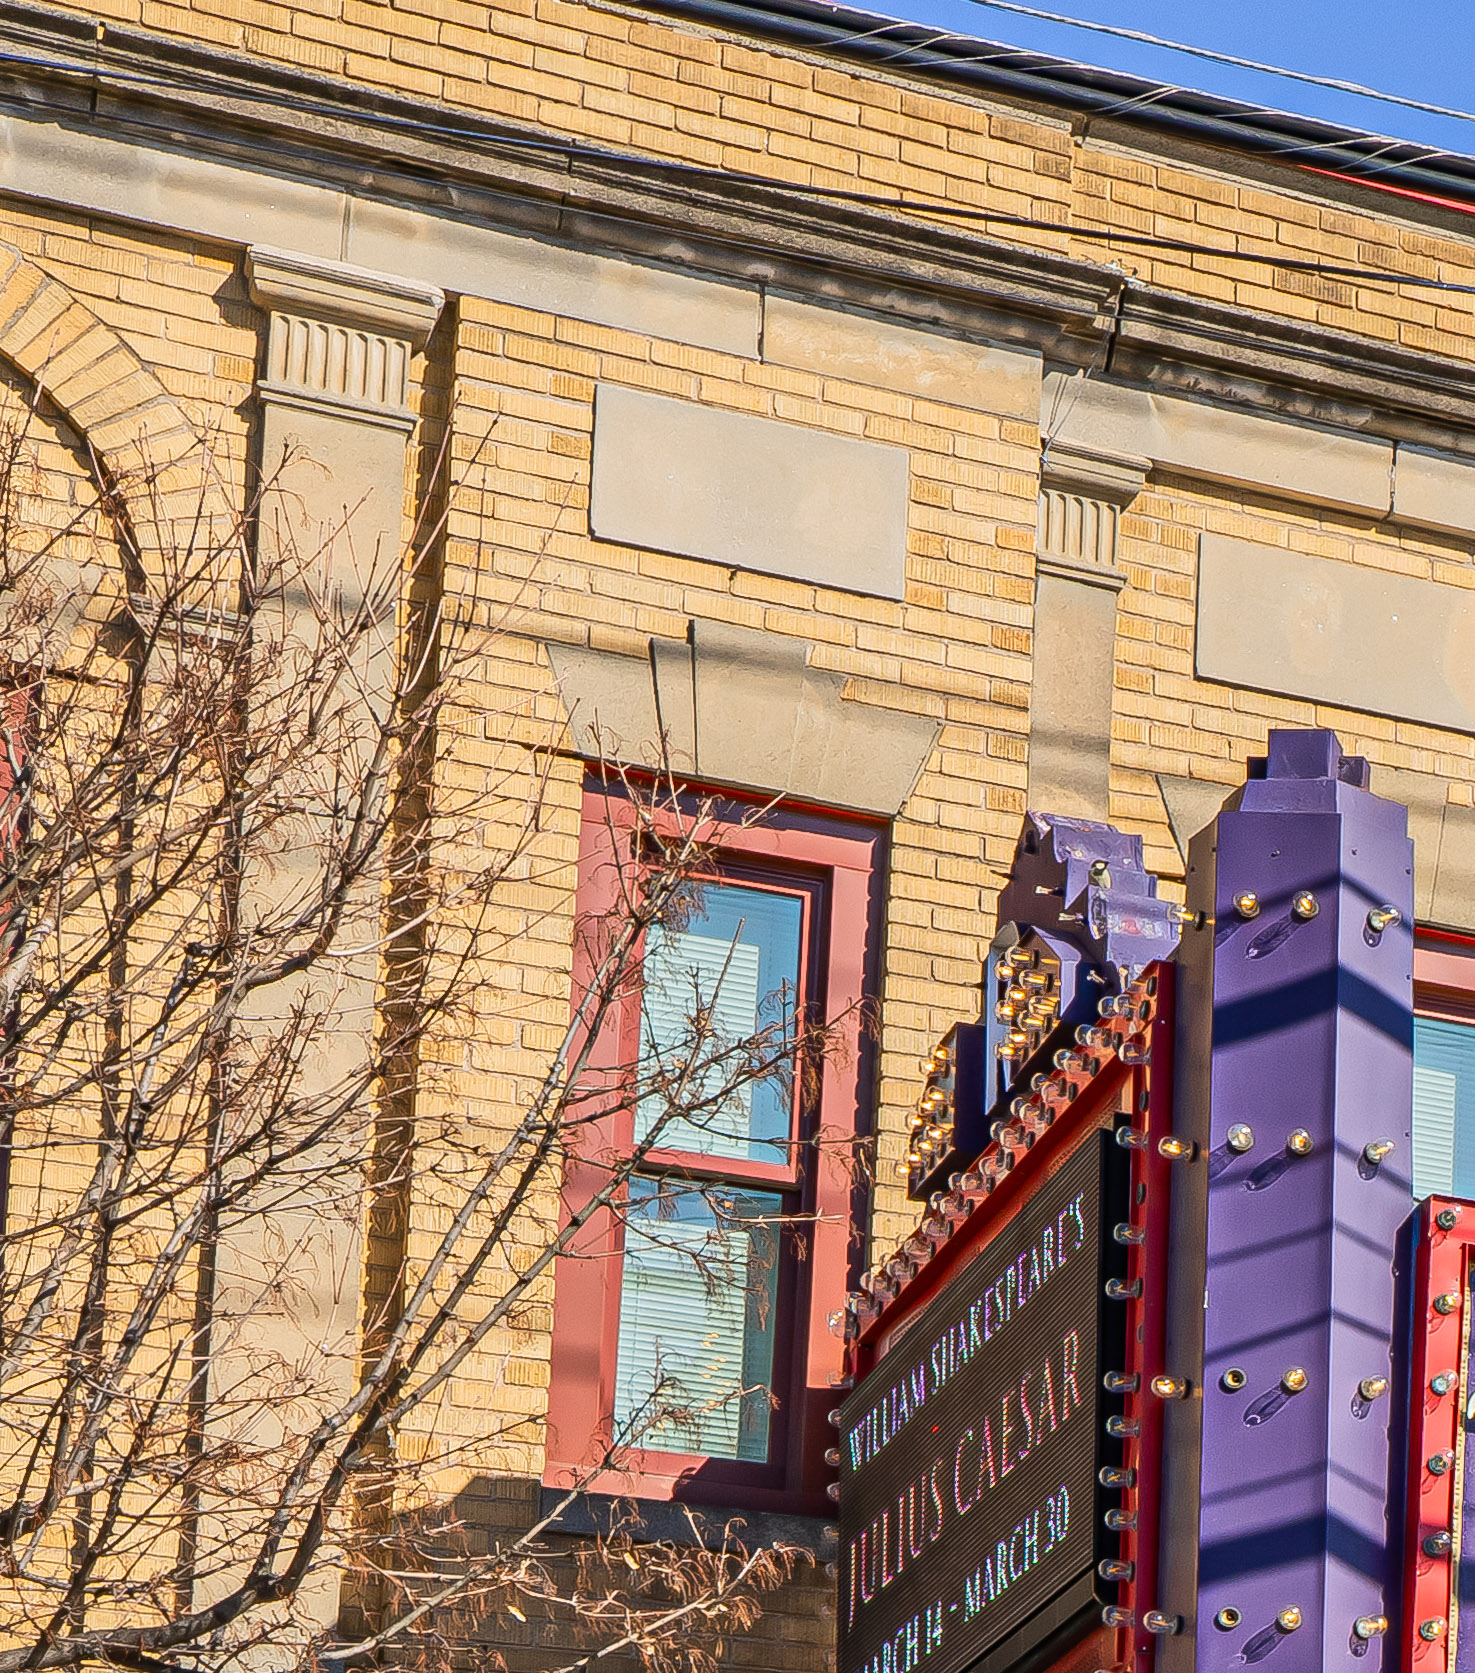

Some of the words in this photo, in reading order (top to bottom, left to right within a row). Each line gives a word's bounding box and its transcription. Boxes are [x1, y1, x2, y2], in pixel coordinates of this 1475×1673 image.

[850, 1360, 925, 1471] WILLIAM
[931, 1191, 1084, 1395] SHAKESPEARE'S
[848, 1457, 943, 1633] JULIUS
[954, 1329, 1081, 1516] CAESAR
[926, 1599, 943, 1656] 14
[964, 1509, 1039, 1623] MARCH
[1045, 1484, 1070, 1554] 30
